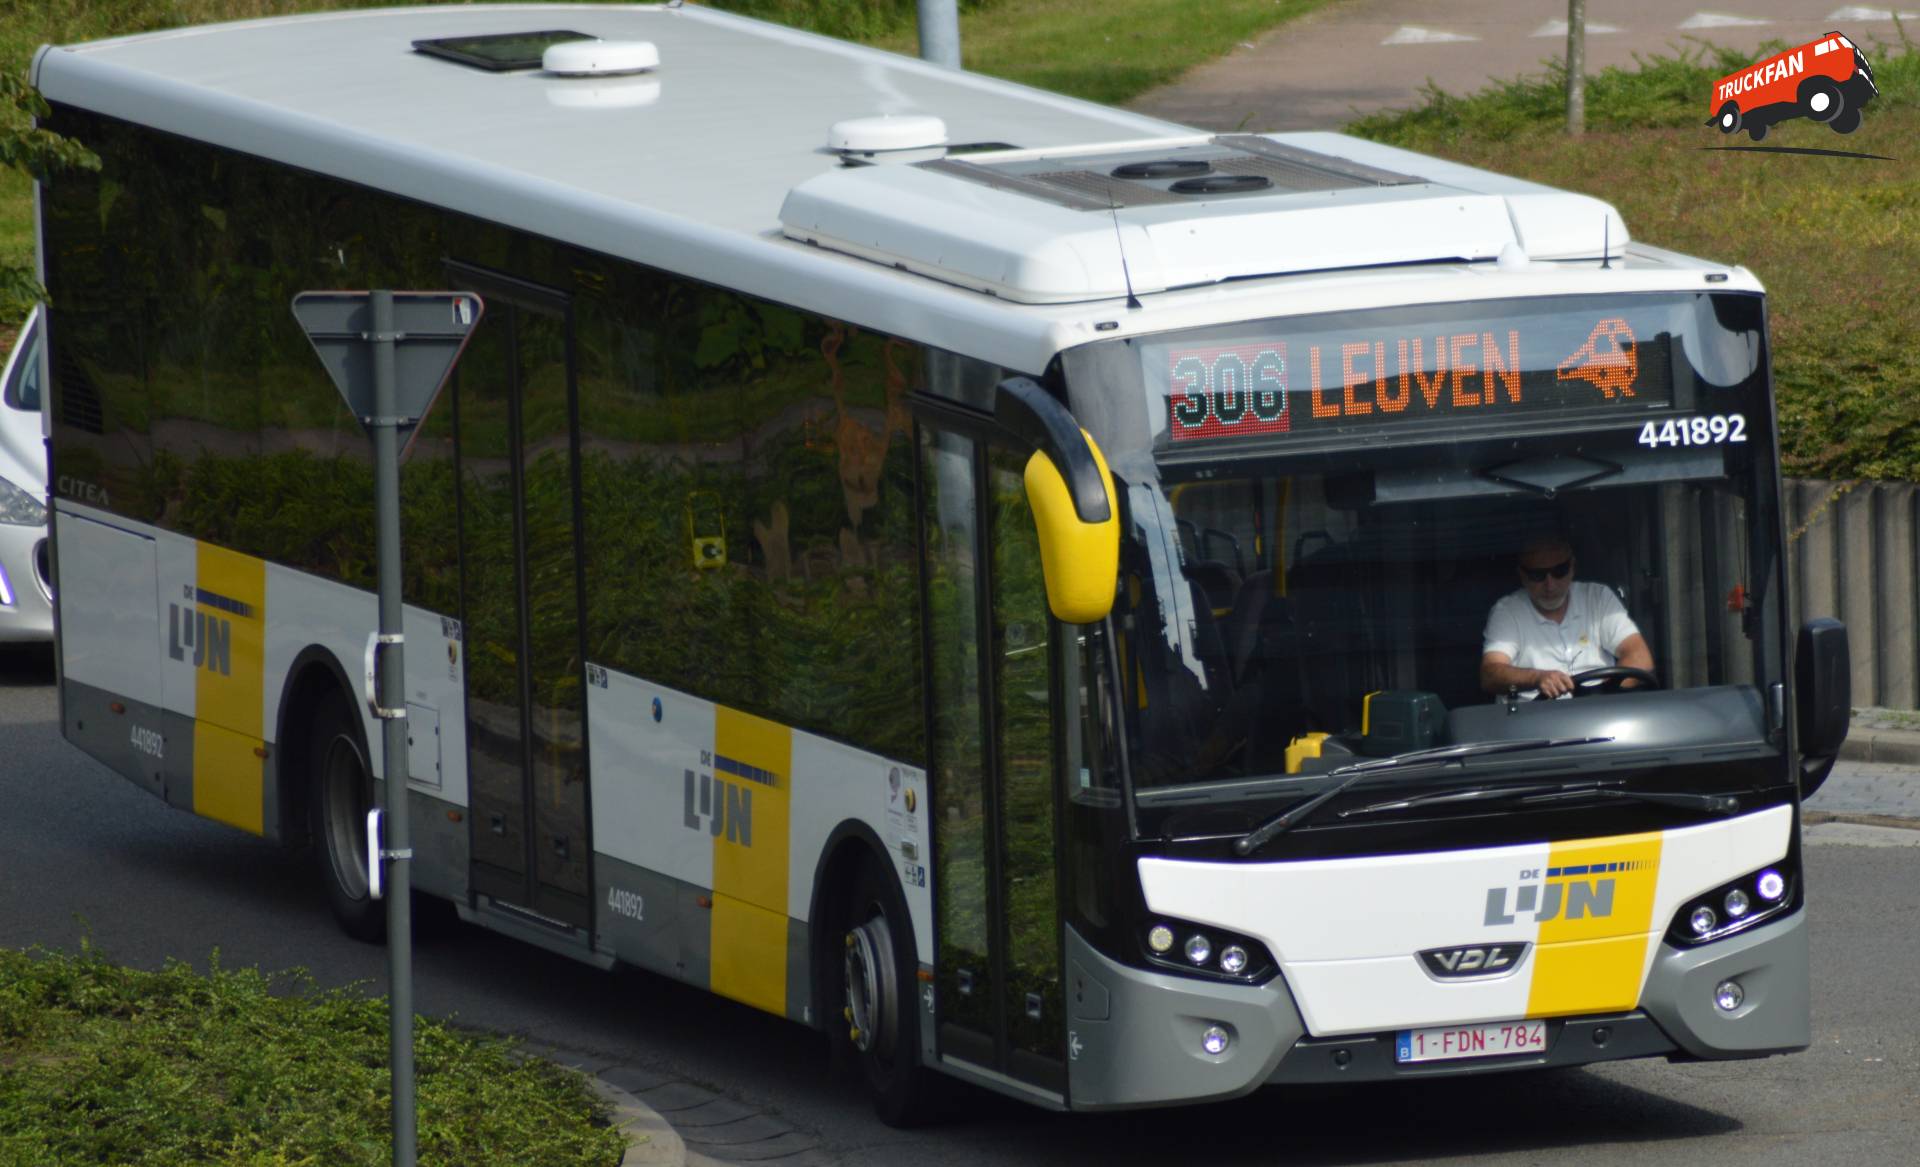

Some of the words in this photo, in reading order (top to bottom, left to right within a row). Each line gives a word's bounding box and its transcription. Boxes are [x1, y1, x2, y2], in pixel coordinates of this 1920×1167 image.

[1173, 350, 1286, 428] 306
[1310, 330, 1522, 419] LEUVEN
[1639, 413, 1747, 448] 441892
[58, 475, 109, 506] CITEA
[169, 602, 231, 677] LIJN
[131, 724, 164, 759] 441892
[684, 768, 752, 848] LIJN
[1519, 868, 1540, 880] DE
[608, 886, 644, 921] 441892
[1483, 878, 1616, 927] LIJN
[1433, 947, 1510, 972] VDL
[1400, 1047, 1409, 1058] B
[1416, 1023, 1542, 1056] 1-FDN-784
